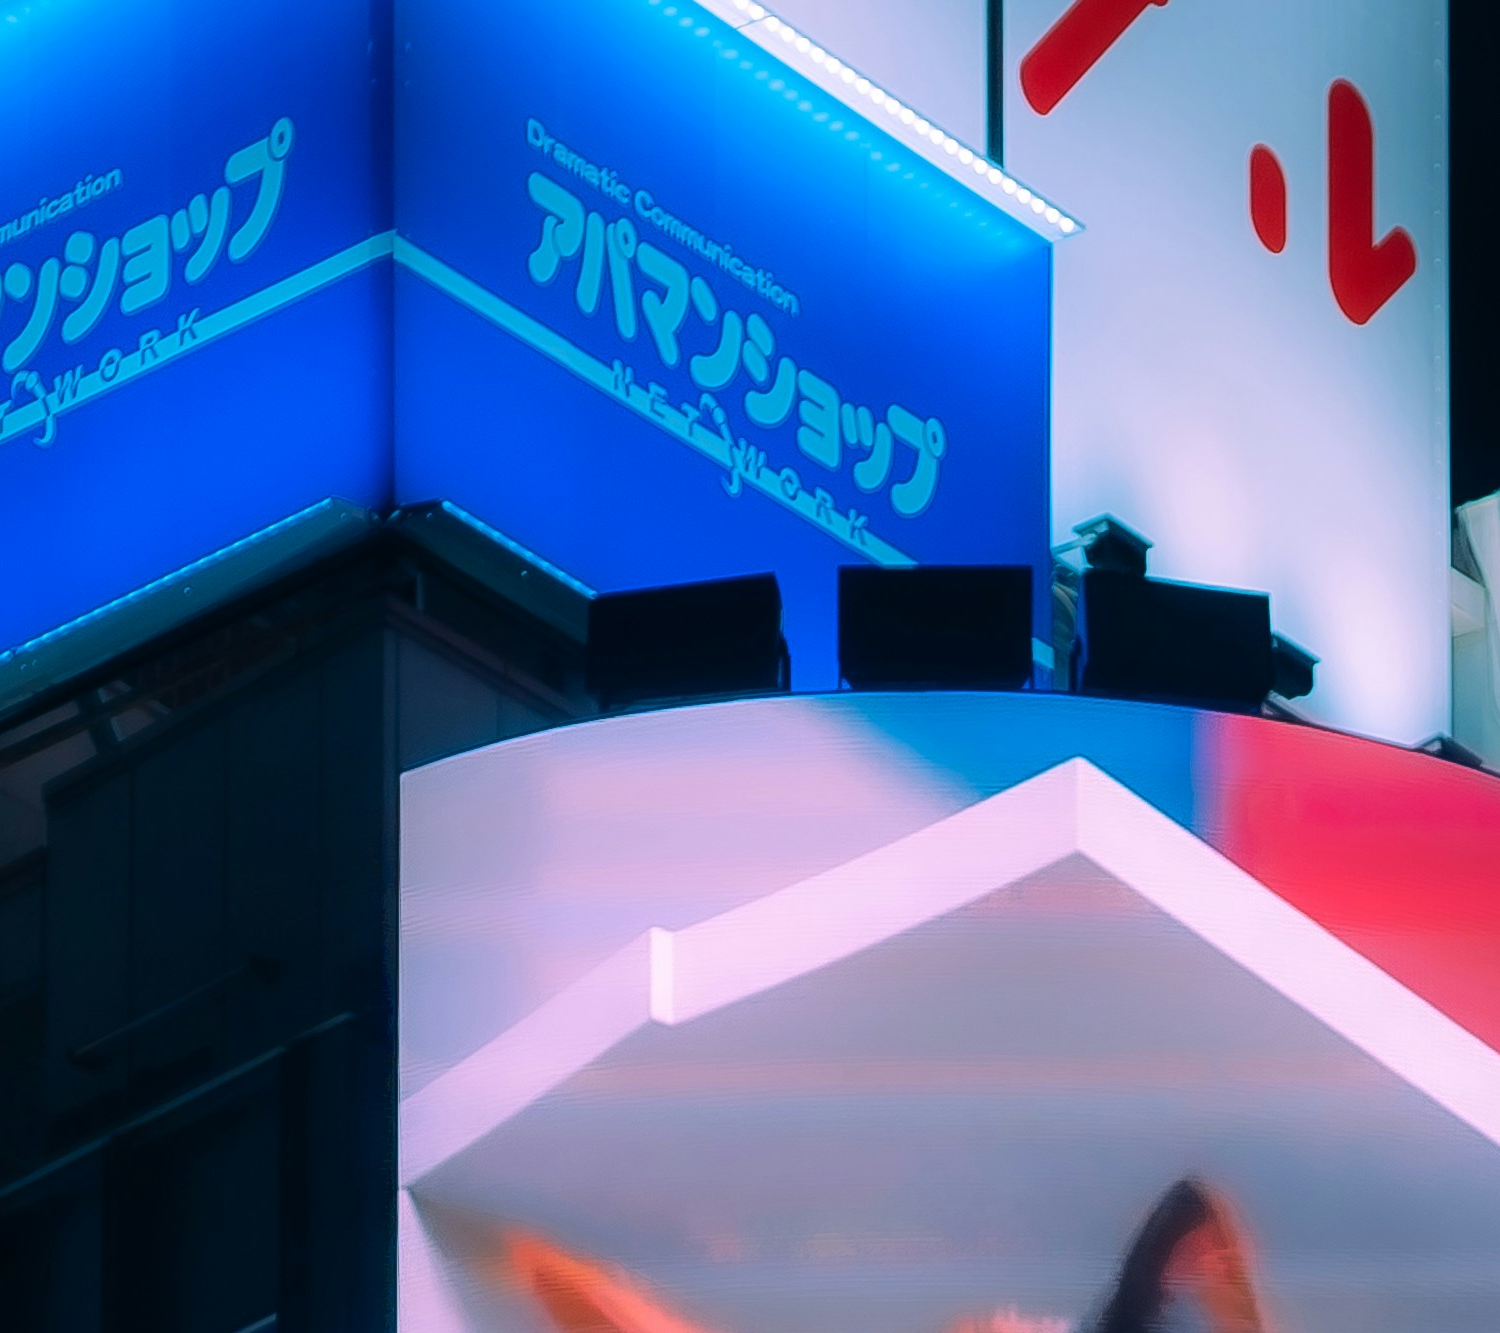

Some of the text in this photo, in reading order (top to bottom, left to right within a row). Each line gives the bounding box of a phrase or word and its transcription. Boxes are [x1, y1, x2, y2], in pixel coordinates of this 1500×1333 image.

[526, 118, 800, 317] Dramatic Communication
[527, 171, 945, 516] アパマンショップ
